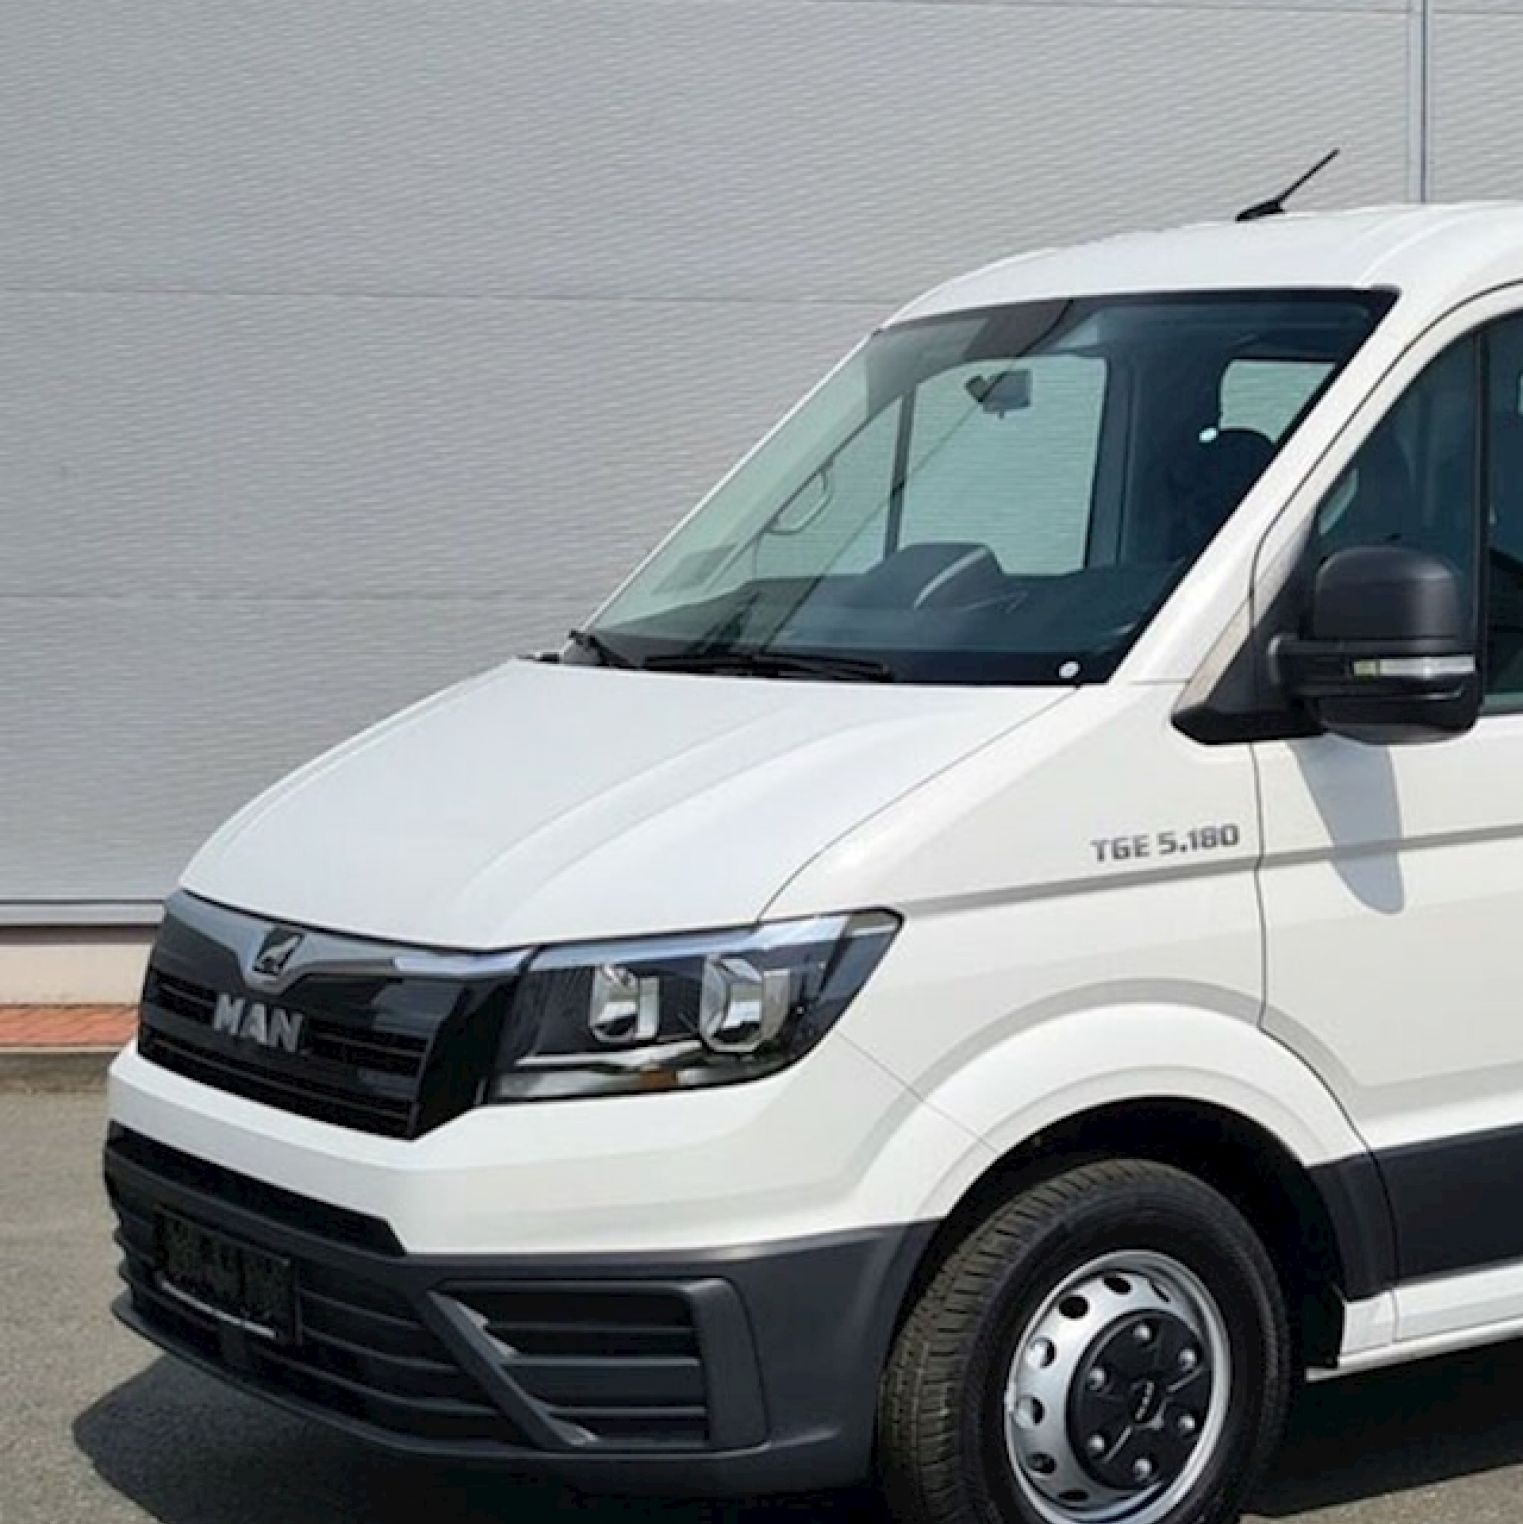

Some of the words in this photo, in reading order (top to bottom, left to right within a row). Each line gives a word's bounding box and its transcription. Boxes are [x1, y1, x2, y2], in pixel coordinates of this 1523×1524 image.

[1090, 834, 1150, 862] TGE
[1157, 823, 1240, 855] 5.180
[212, 993, 303, 1052] MAN
